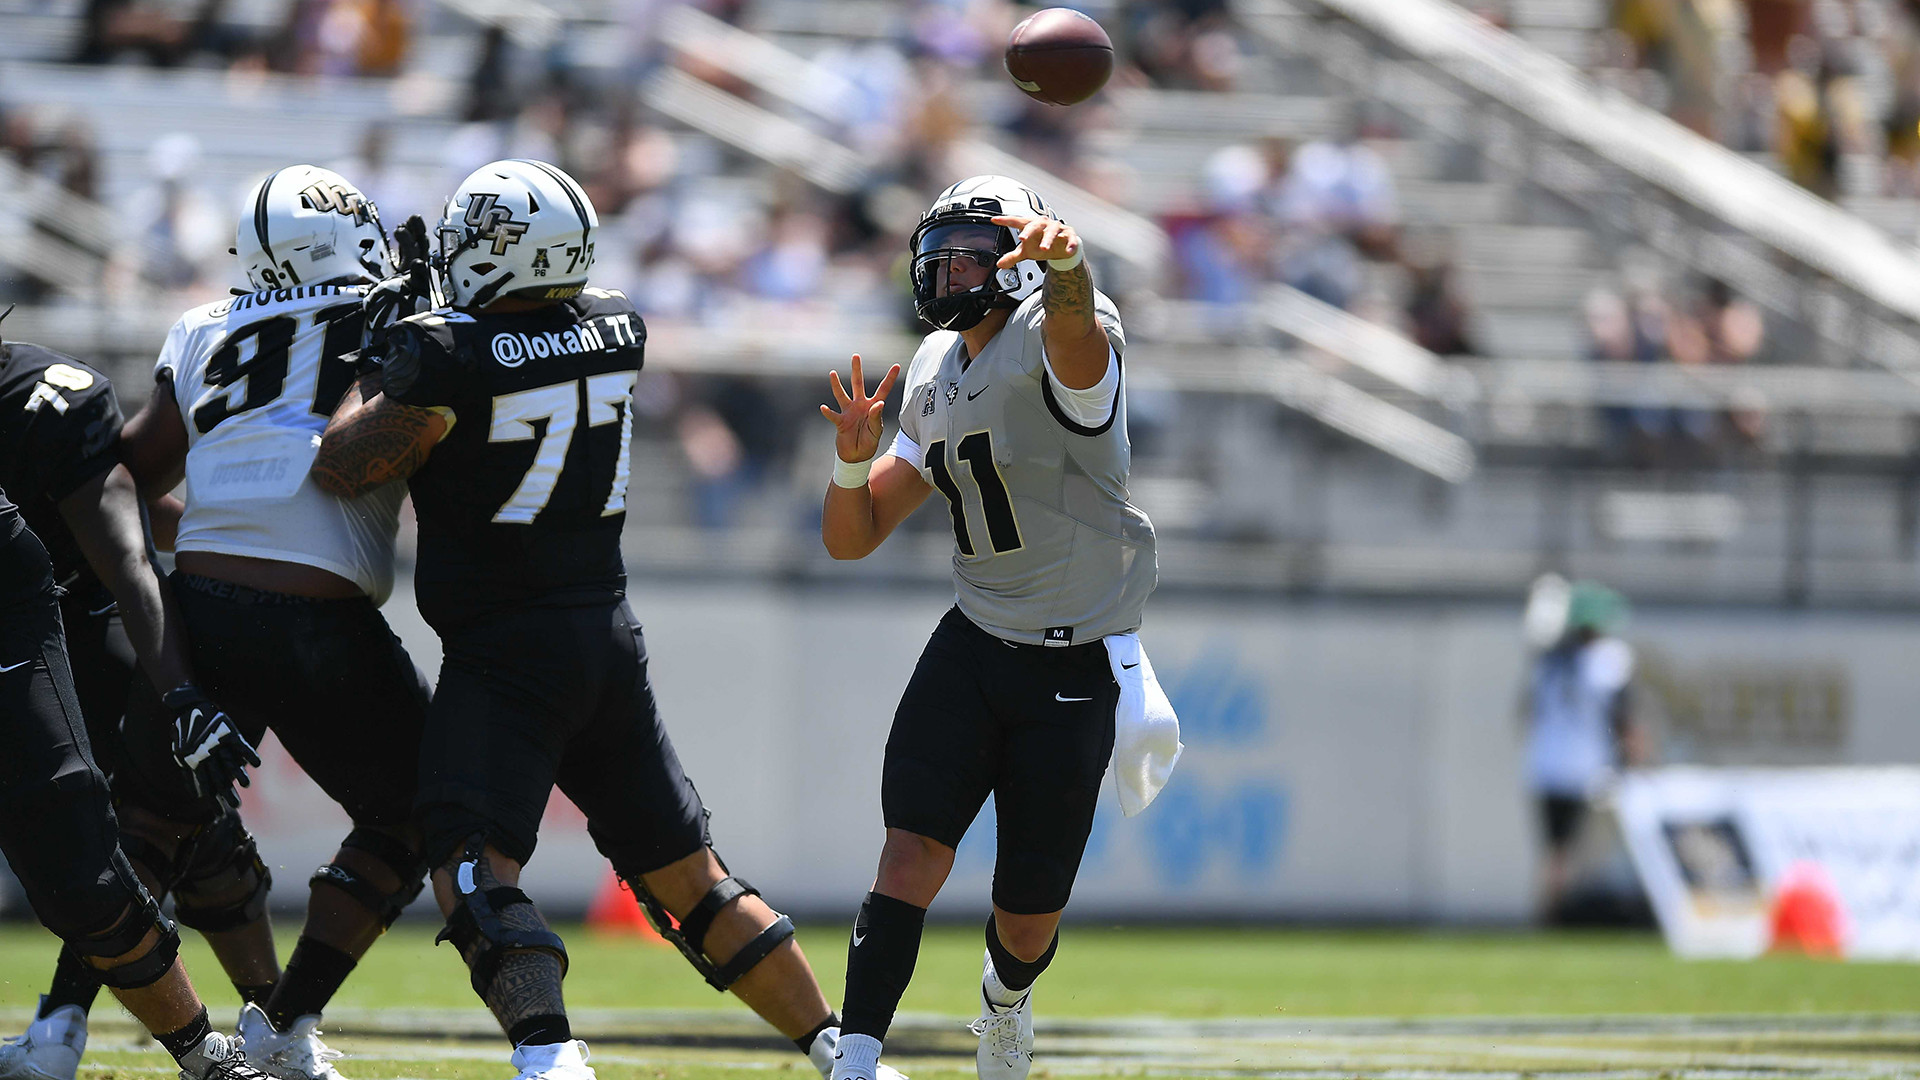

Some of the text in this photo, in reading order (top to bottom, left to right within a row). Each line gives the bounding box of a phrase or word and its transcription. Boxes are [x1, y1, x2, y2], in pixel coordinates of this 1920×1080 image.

[464, 193, 530, 256] UCF
[534, 269, 546, 277] P6
[492, 314, 637, 368] @lokahi_77
[487, 370, 639, 525] 77
[924, 428, 1025, 558] 11
[1053, 629, 1065, 638] M
